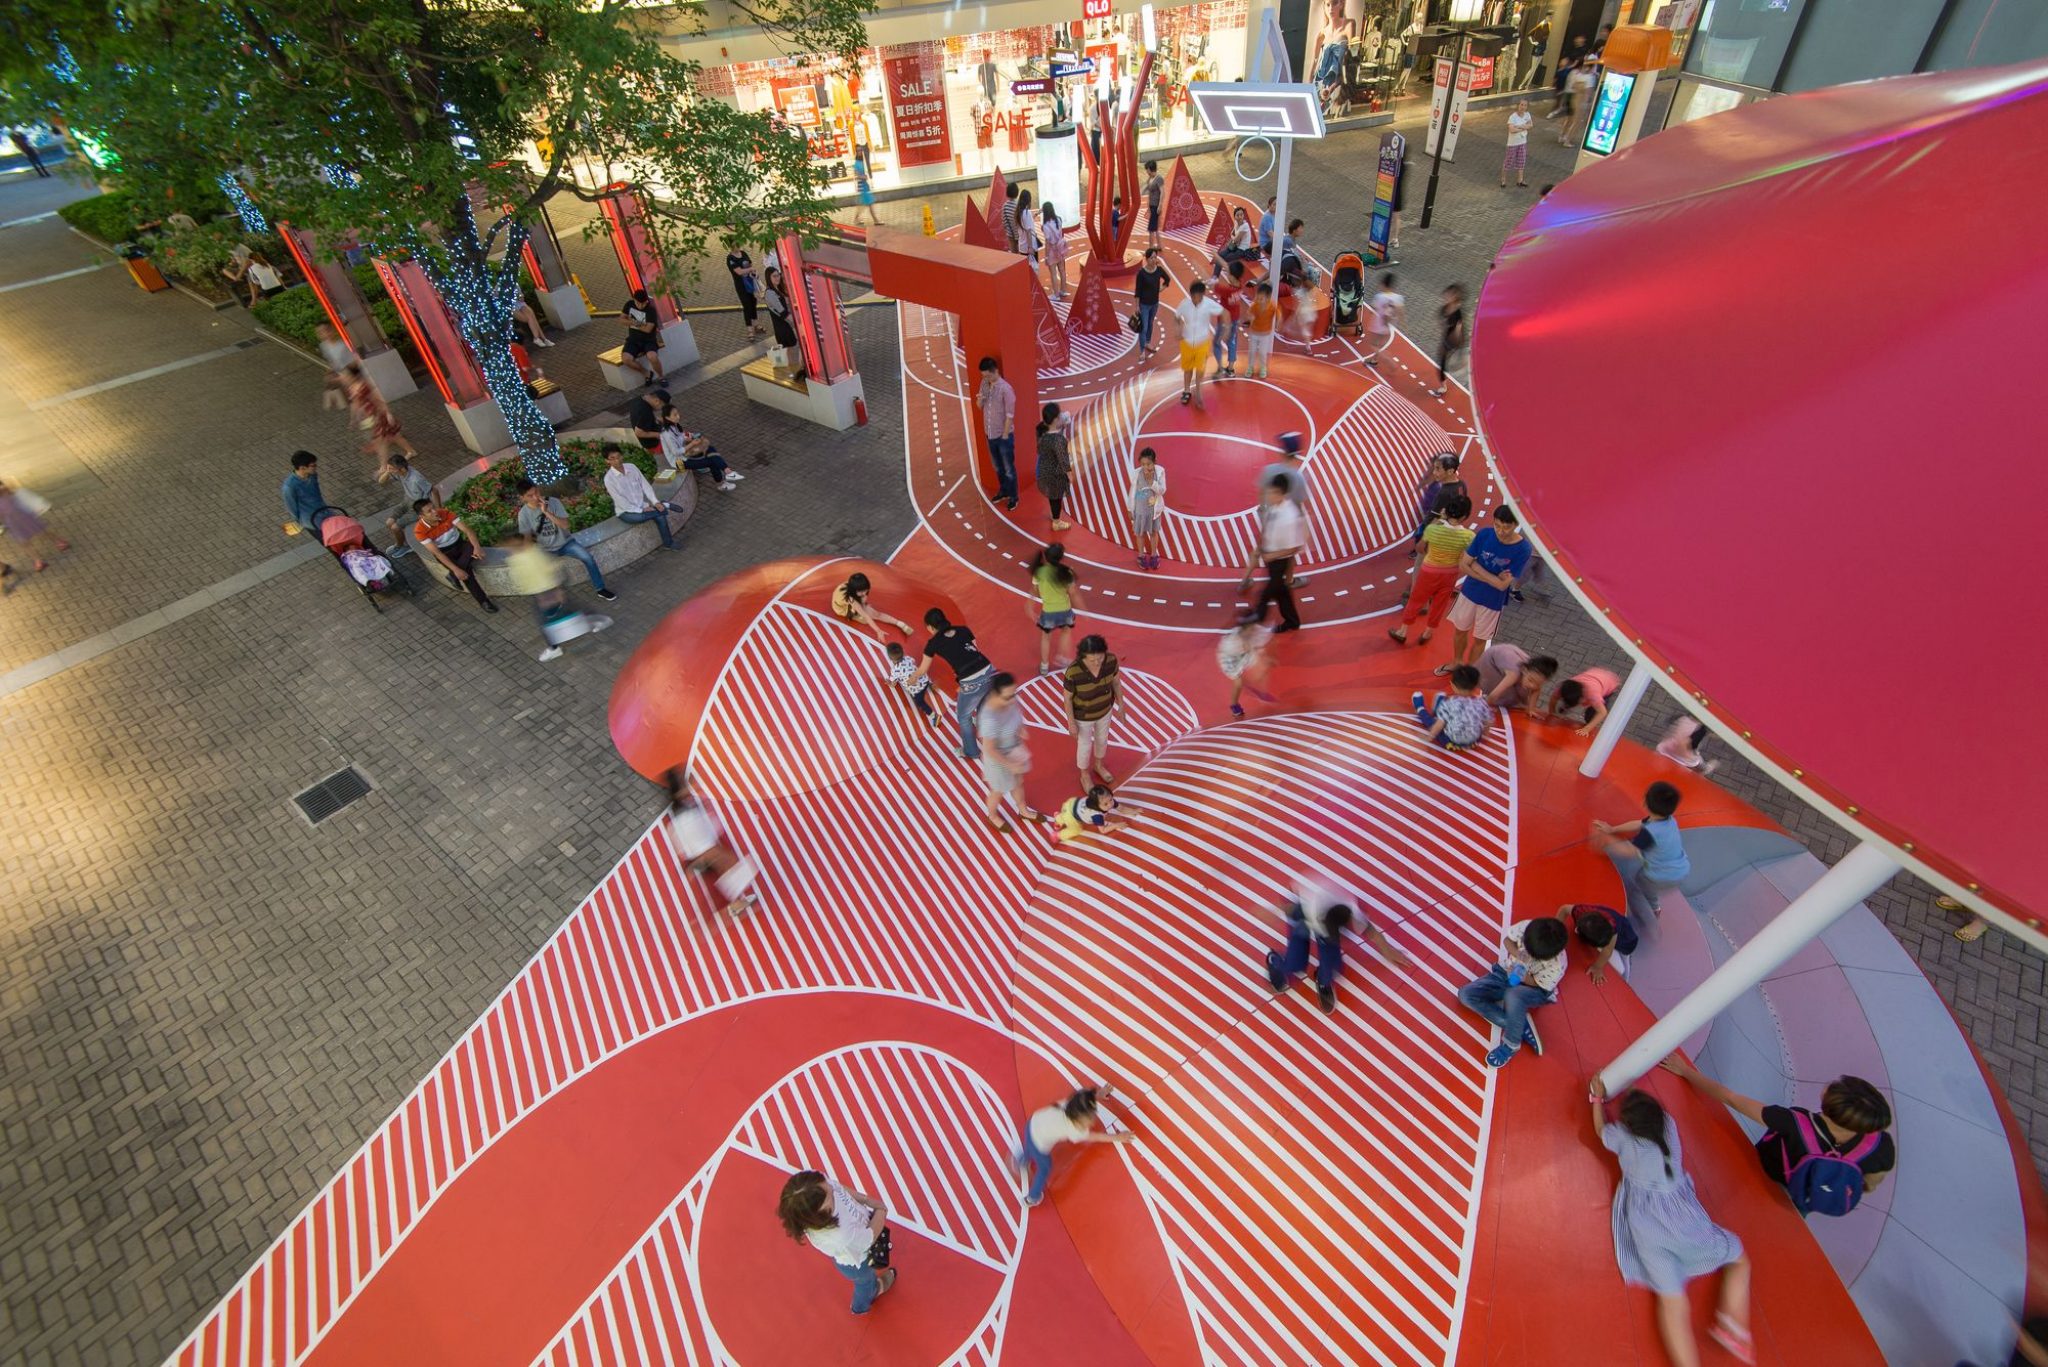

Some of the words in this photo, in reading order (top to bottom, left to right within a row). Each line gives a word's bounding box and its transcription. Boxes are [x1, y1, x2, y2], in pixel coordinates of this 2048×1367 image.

[1086, 1, 1109, 16] QLO
[900, 81, 932, 98] SALE
[895, 100, 943, 117] 夏日折扣季
[982, 107, 1034, 133] SALE
[807, 133, 849, 160] ALE
